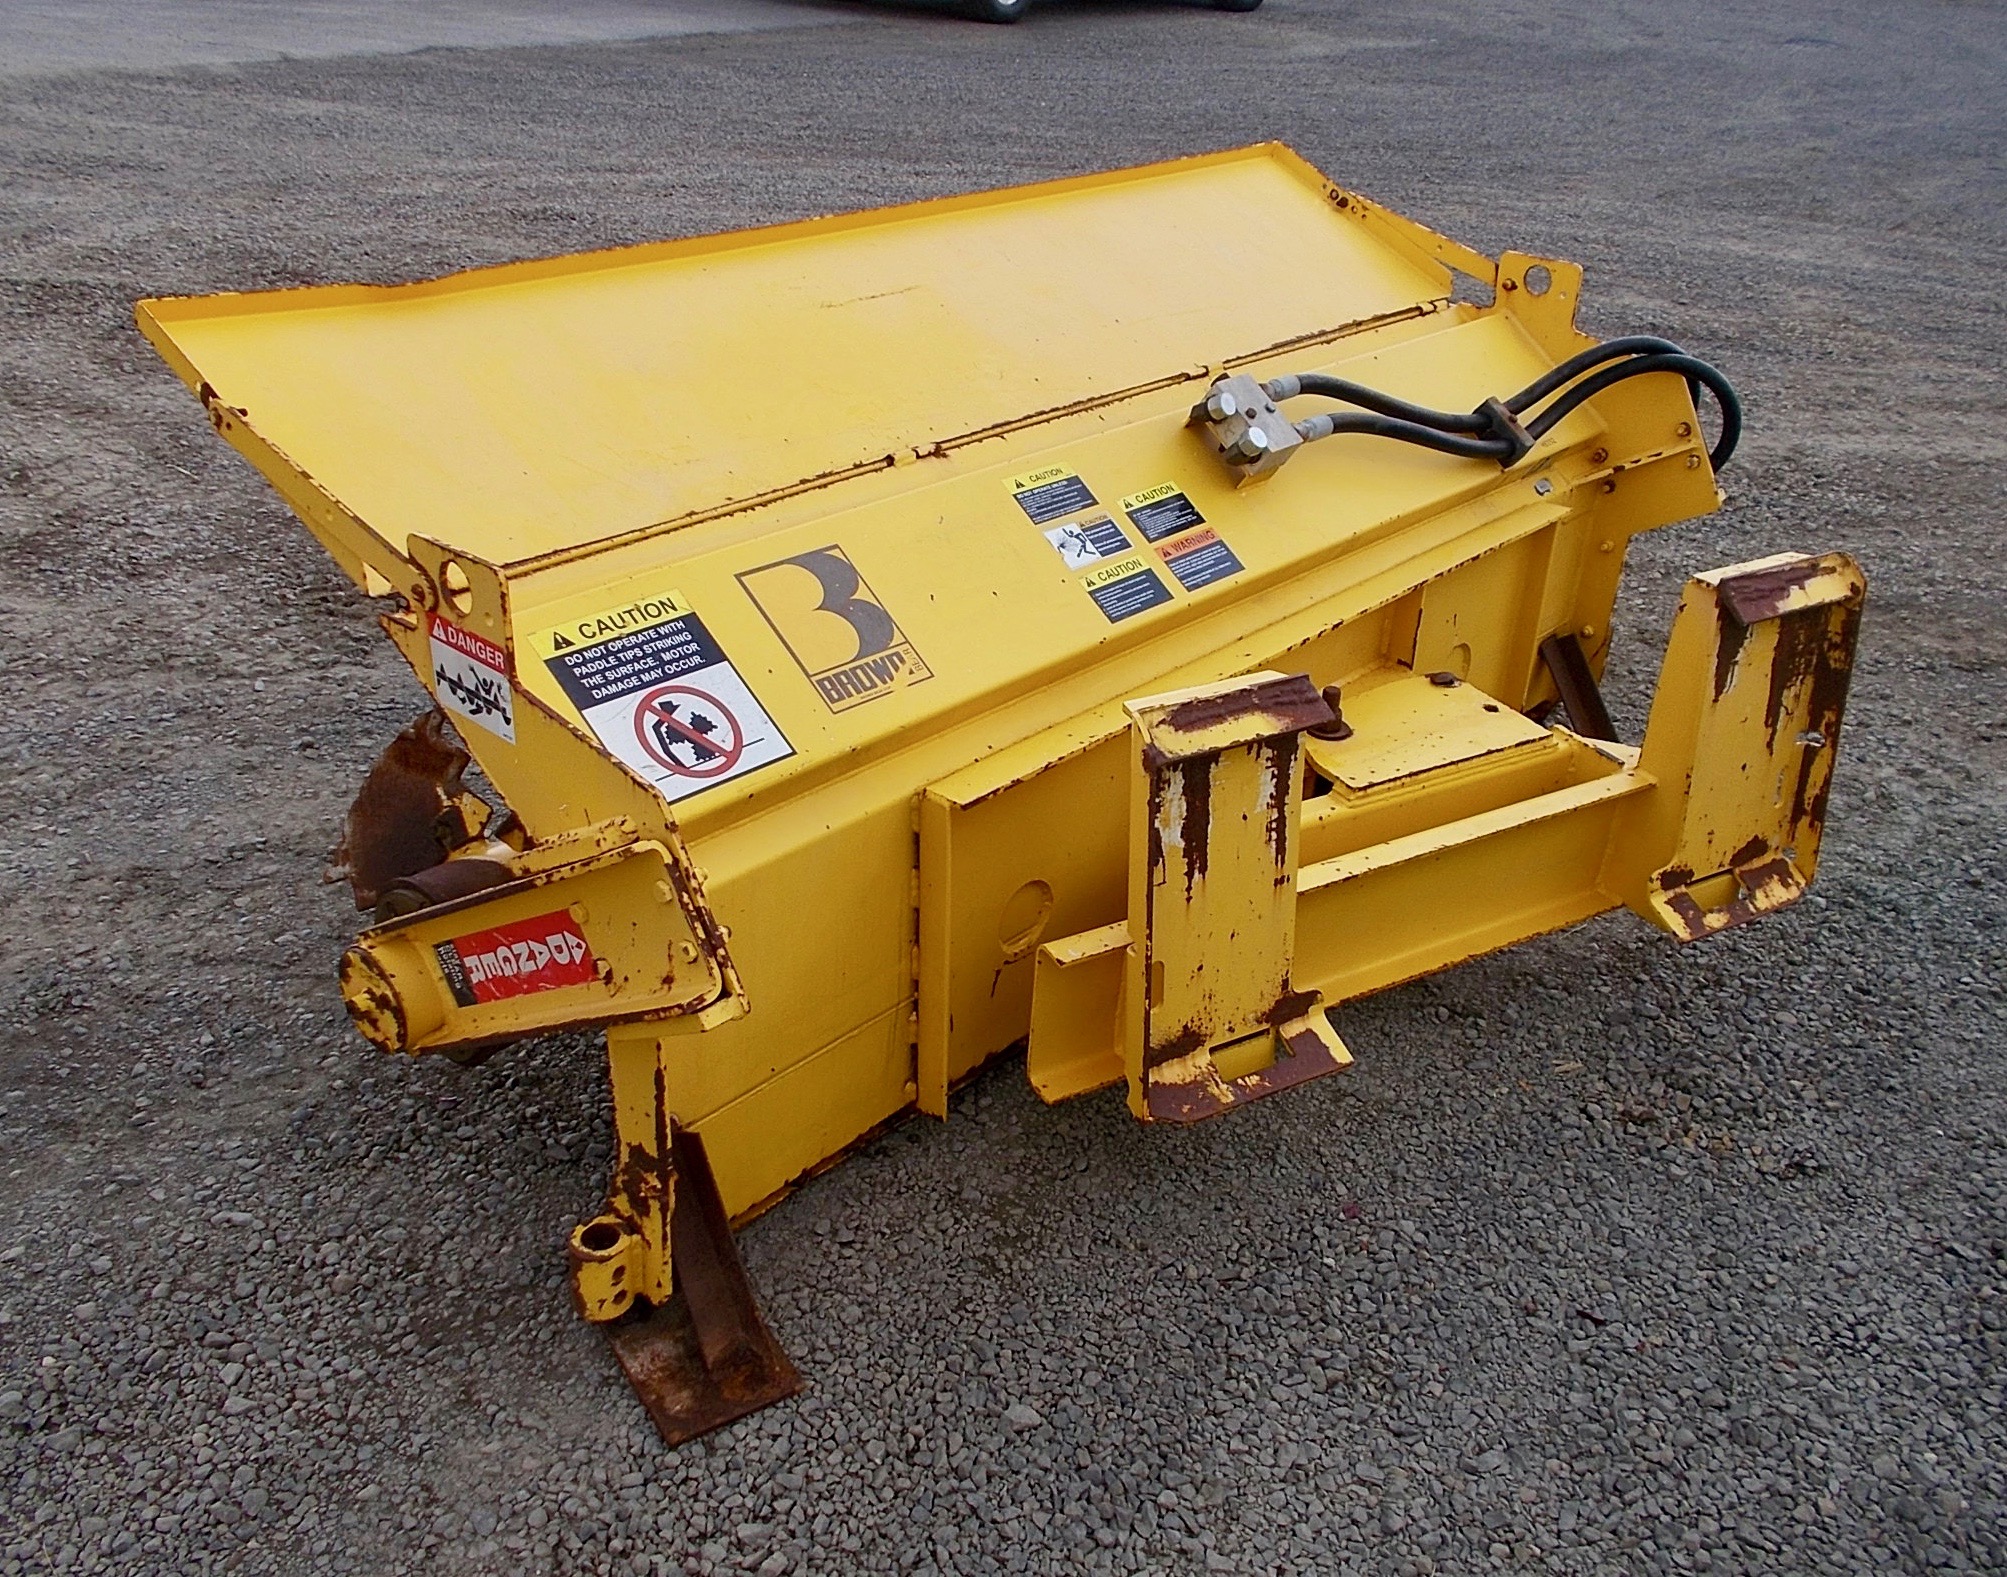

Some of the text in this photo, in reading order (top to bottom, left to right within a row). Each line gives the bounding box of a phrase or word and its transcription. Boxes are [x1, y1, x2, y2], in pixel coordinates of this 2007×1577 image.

[1028, 468, 1064, 483] CAUTION
[1135, 483, 1175, 504] CAUTION
[1171, 530, 1216, 553] WARNING
[1097, 558, 1143, 582] CAUTION
[578, 597, 678, 640] CAUTION
[447, 626, 505, 669] DANGER
[564, 620, 686, 666] DO NOT OPERATE WITH
[573, 631, 692, 677] PADDLE TIPS STRIKING
[580, 642, 701, 689] THE SURFACE. MOTOR
[591, 655, 706, 700] DAMAGE MAY OCCUR.
[463, 933, 571, 984] DANGER
